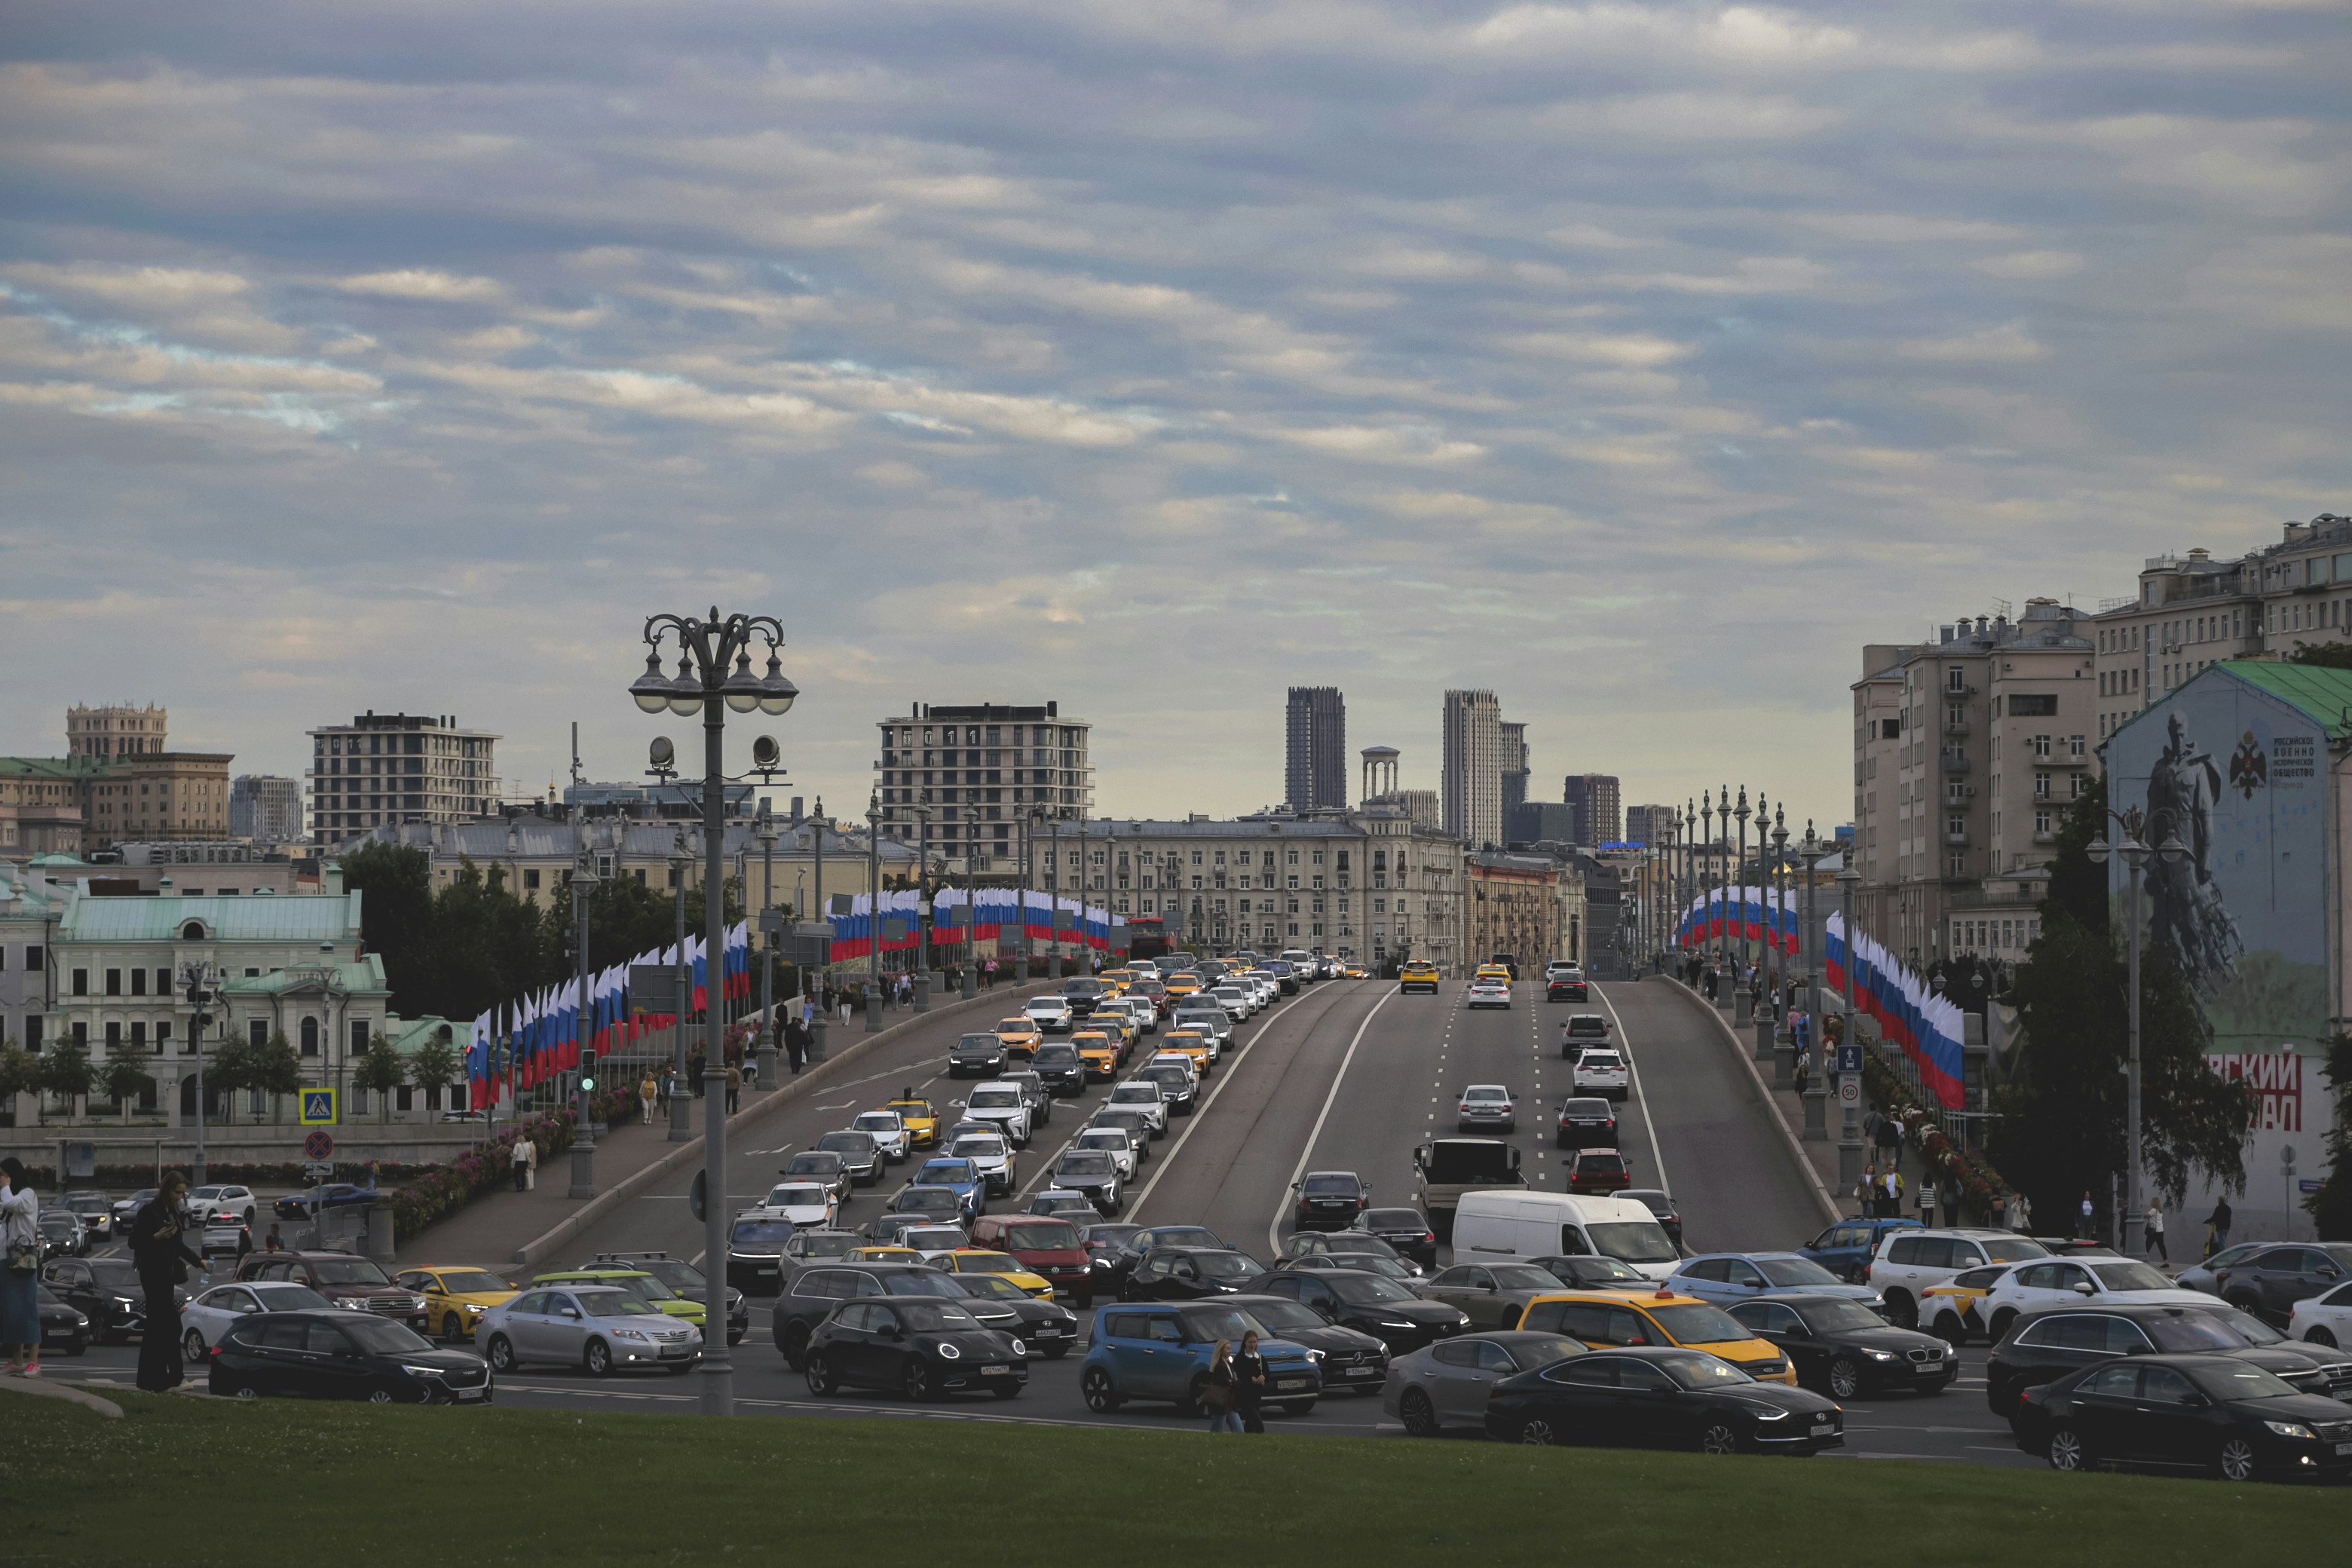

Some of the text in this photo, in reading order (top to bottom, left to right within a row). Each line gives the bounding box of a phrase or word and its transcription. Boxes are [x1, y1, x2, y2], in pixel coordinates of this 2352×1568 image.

[2274, 736, 2314, 745] РОССИЙСКОЕ
[2274, 747, 2314, 757] ВОЕННО
[2274, 768, 2314, 778] ОБЩЕСТВО
